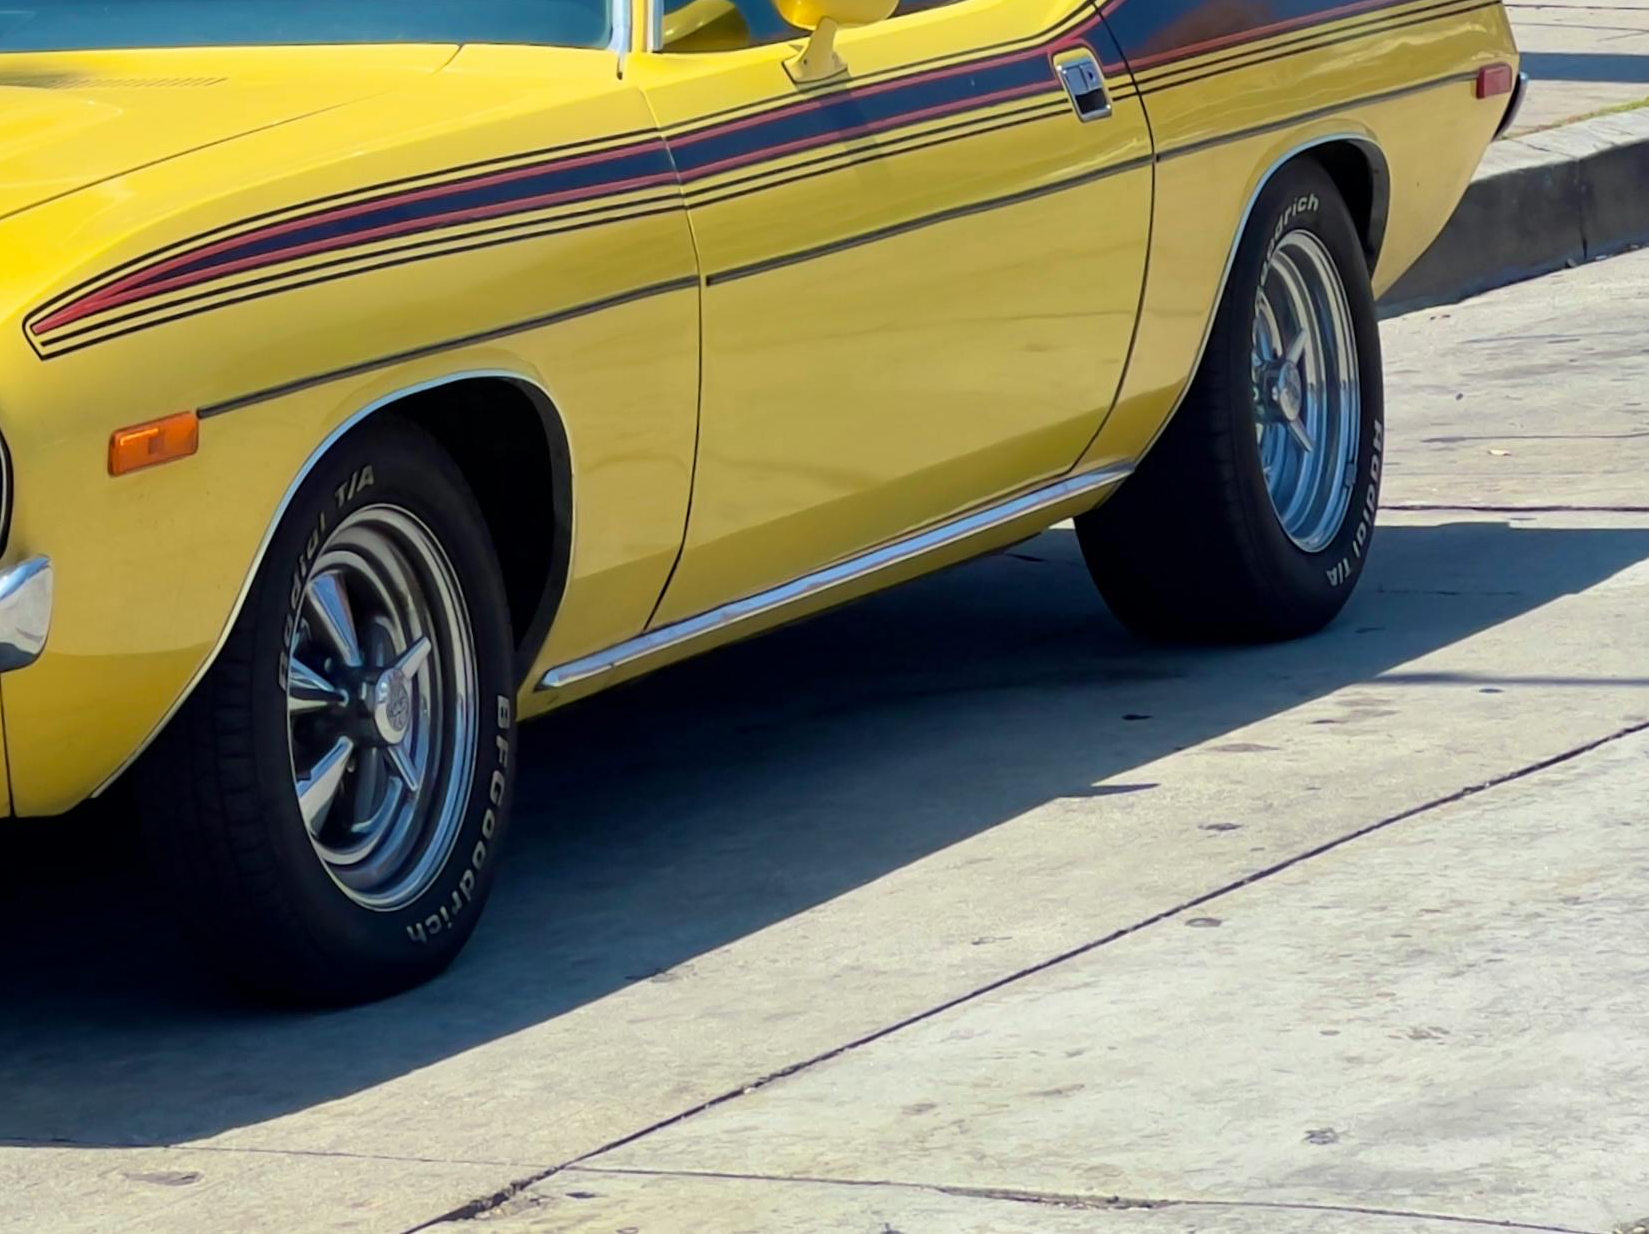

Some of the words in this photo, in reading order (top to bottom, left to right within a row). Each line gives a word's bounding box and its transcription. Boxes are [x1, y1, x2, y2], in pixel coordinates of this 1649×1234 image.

[335, 465, 375, 508] T/A
[1353, 419, 1384, 559] Radial
[1326, 557, 1352, 587] T/A
[406, 695, 511, 944] BFGoodrich
